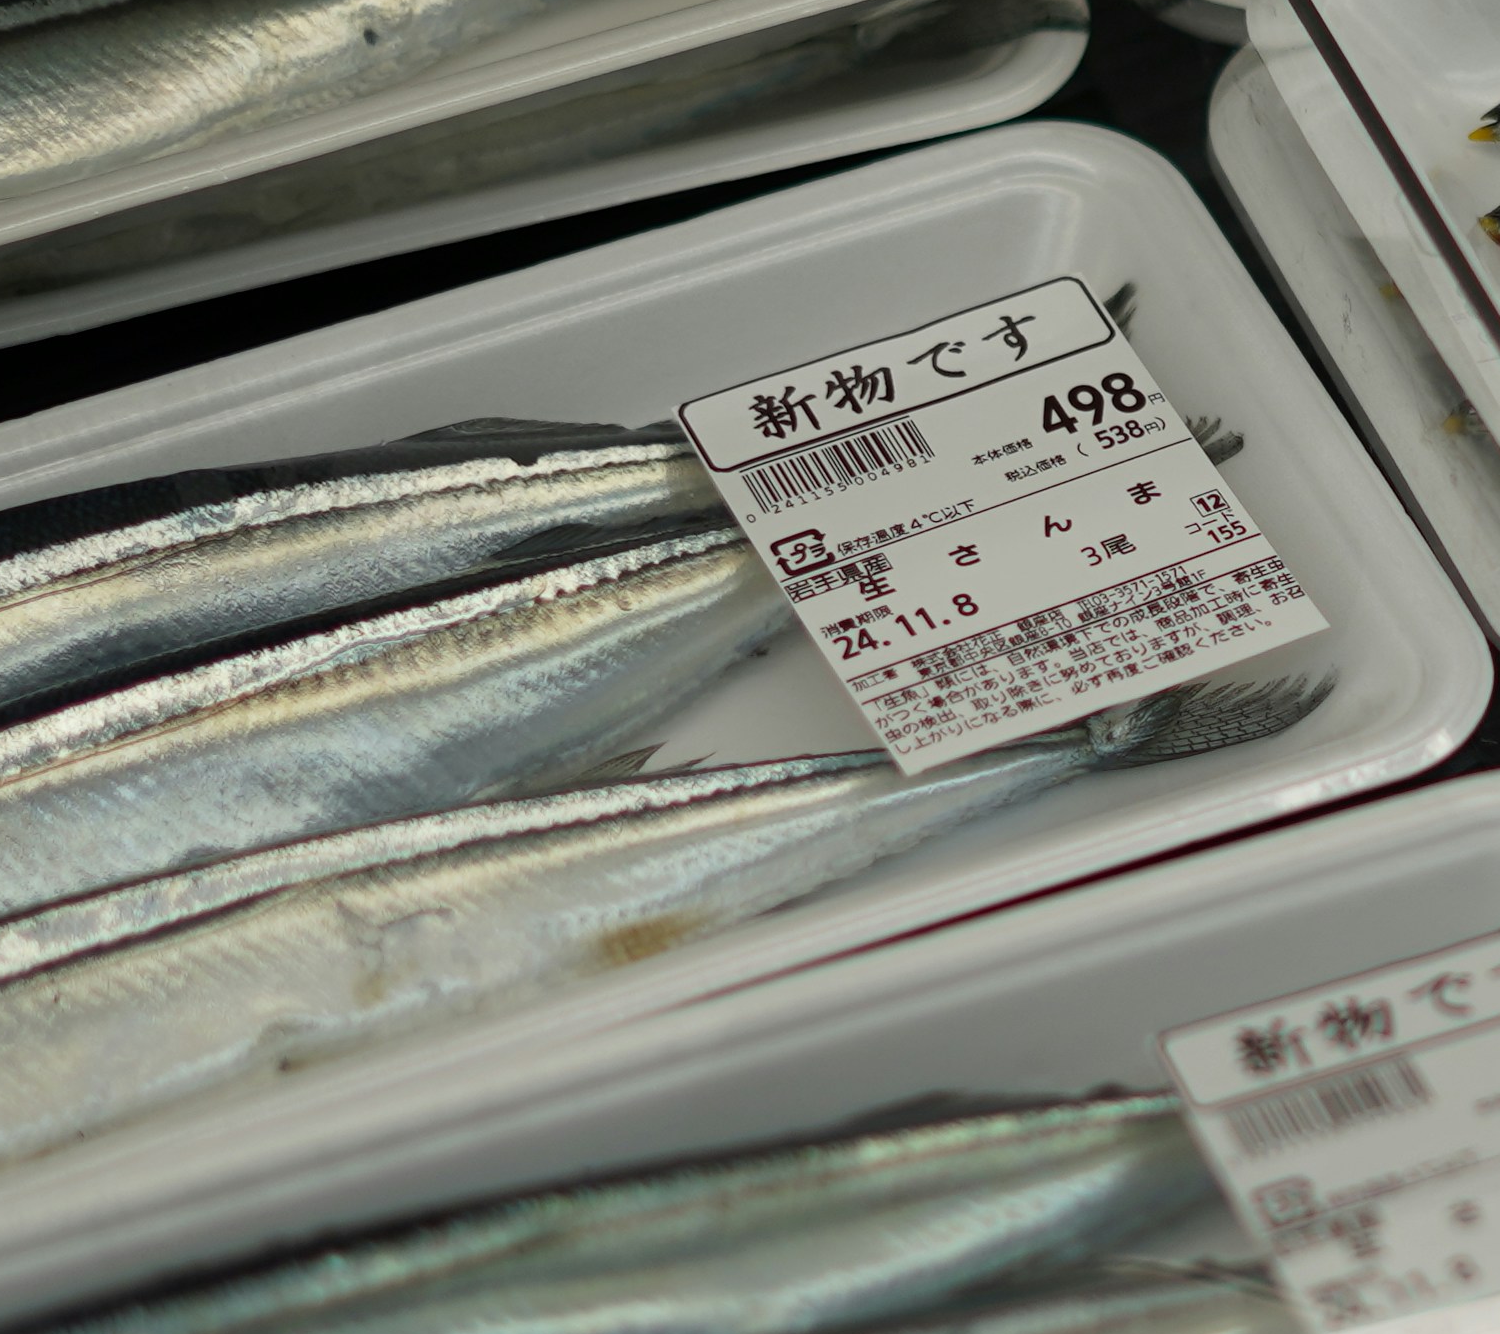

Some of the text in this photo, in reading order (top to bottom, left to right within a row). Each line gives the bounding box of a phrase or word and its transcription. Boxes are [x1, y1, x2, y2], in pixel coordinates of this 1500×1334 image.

[750, 315, 1033, 438] 新物です
[970, 437, 1033, 465] 本体価格
[1195, 492, 1226, 513] 12
[1206, 519, 1247, 544] 155
[1080, 532, 1137, 566] 3尾
[786, 553, 890, 601] 岩手県産
[819, 604, 893, 638] 消費期限
